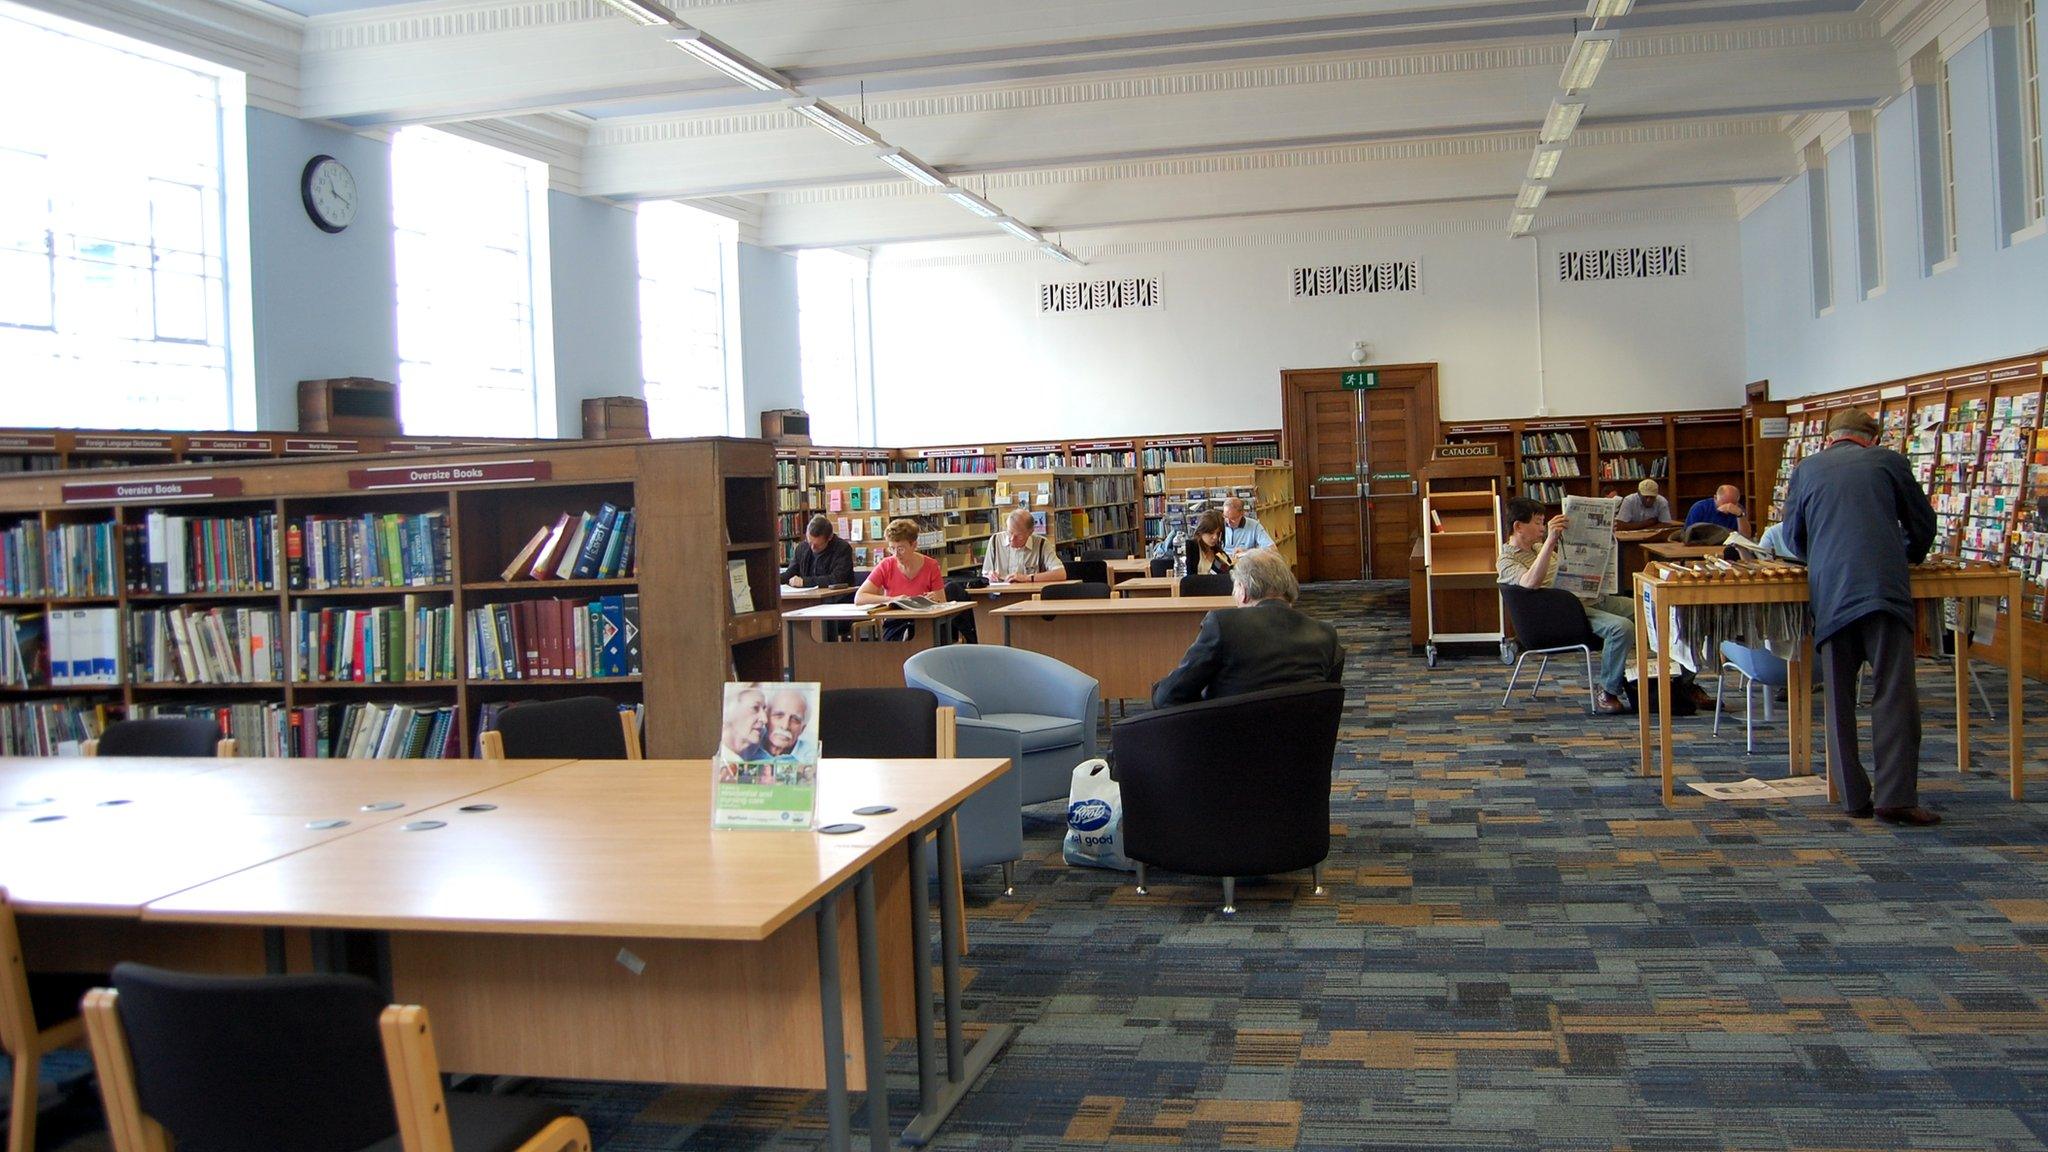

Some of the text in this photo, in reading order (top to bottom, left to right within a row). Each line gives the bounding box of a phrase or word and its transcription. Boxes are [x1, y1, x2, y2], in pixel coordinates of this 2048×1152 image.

[1441, 446, 1489, 456] CATALOGUE
[410, 468, 484, 481] Oversize Books
[117, 484, 182, 496] Oversize Books
[1072, 805, 1106, 824] Boots
[1085, 834, 1113, 847] good
